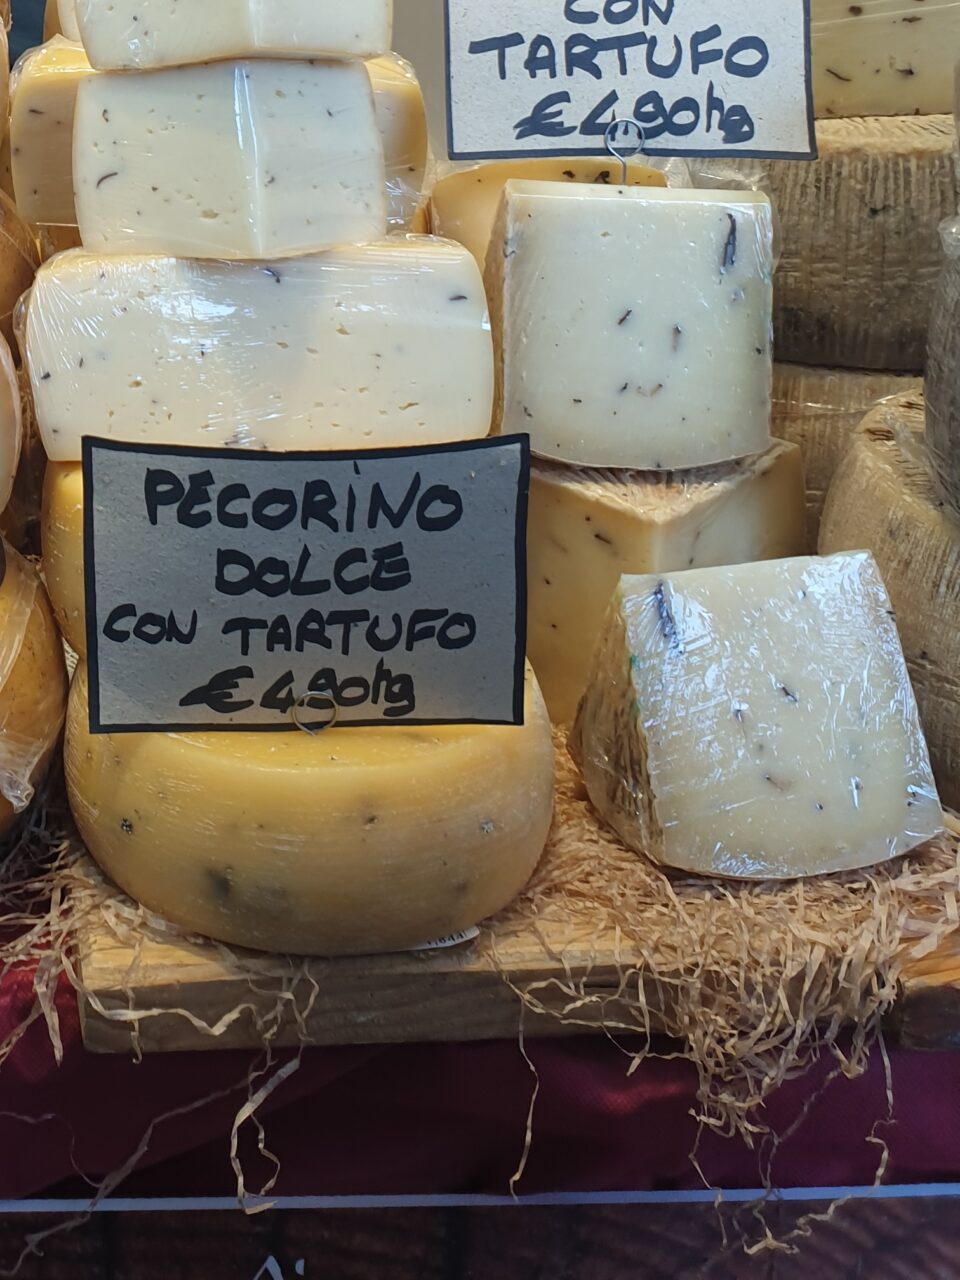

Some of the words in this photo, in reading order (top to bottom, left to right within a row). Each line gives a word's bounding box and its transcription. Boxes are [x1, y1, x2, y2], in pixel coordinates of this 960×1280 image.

[468, 23, 770, 80] TARTUFO
[215, 542, 412, 598] DOLCE
[103, 603, 198, 645] CON
[221, 608, 477, 656] TARTUFO
